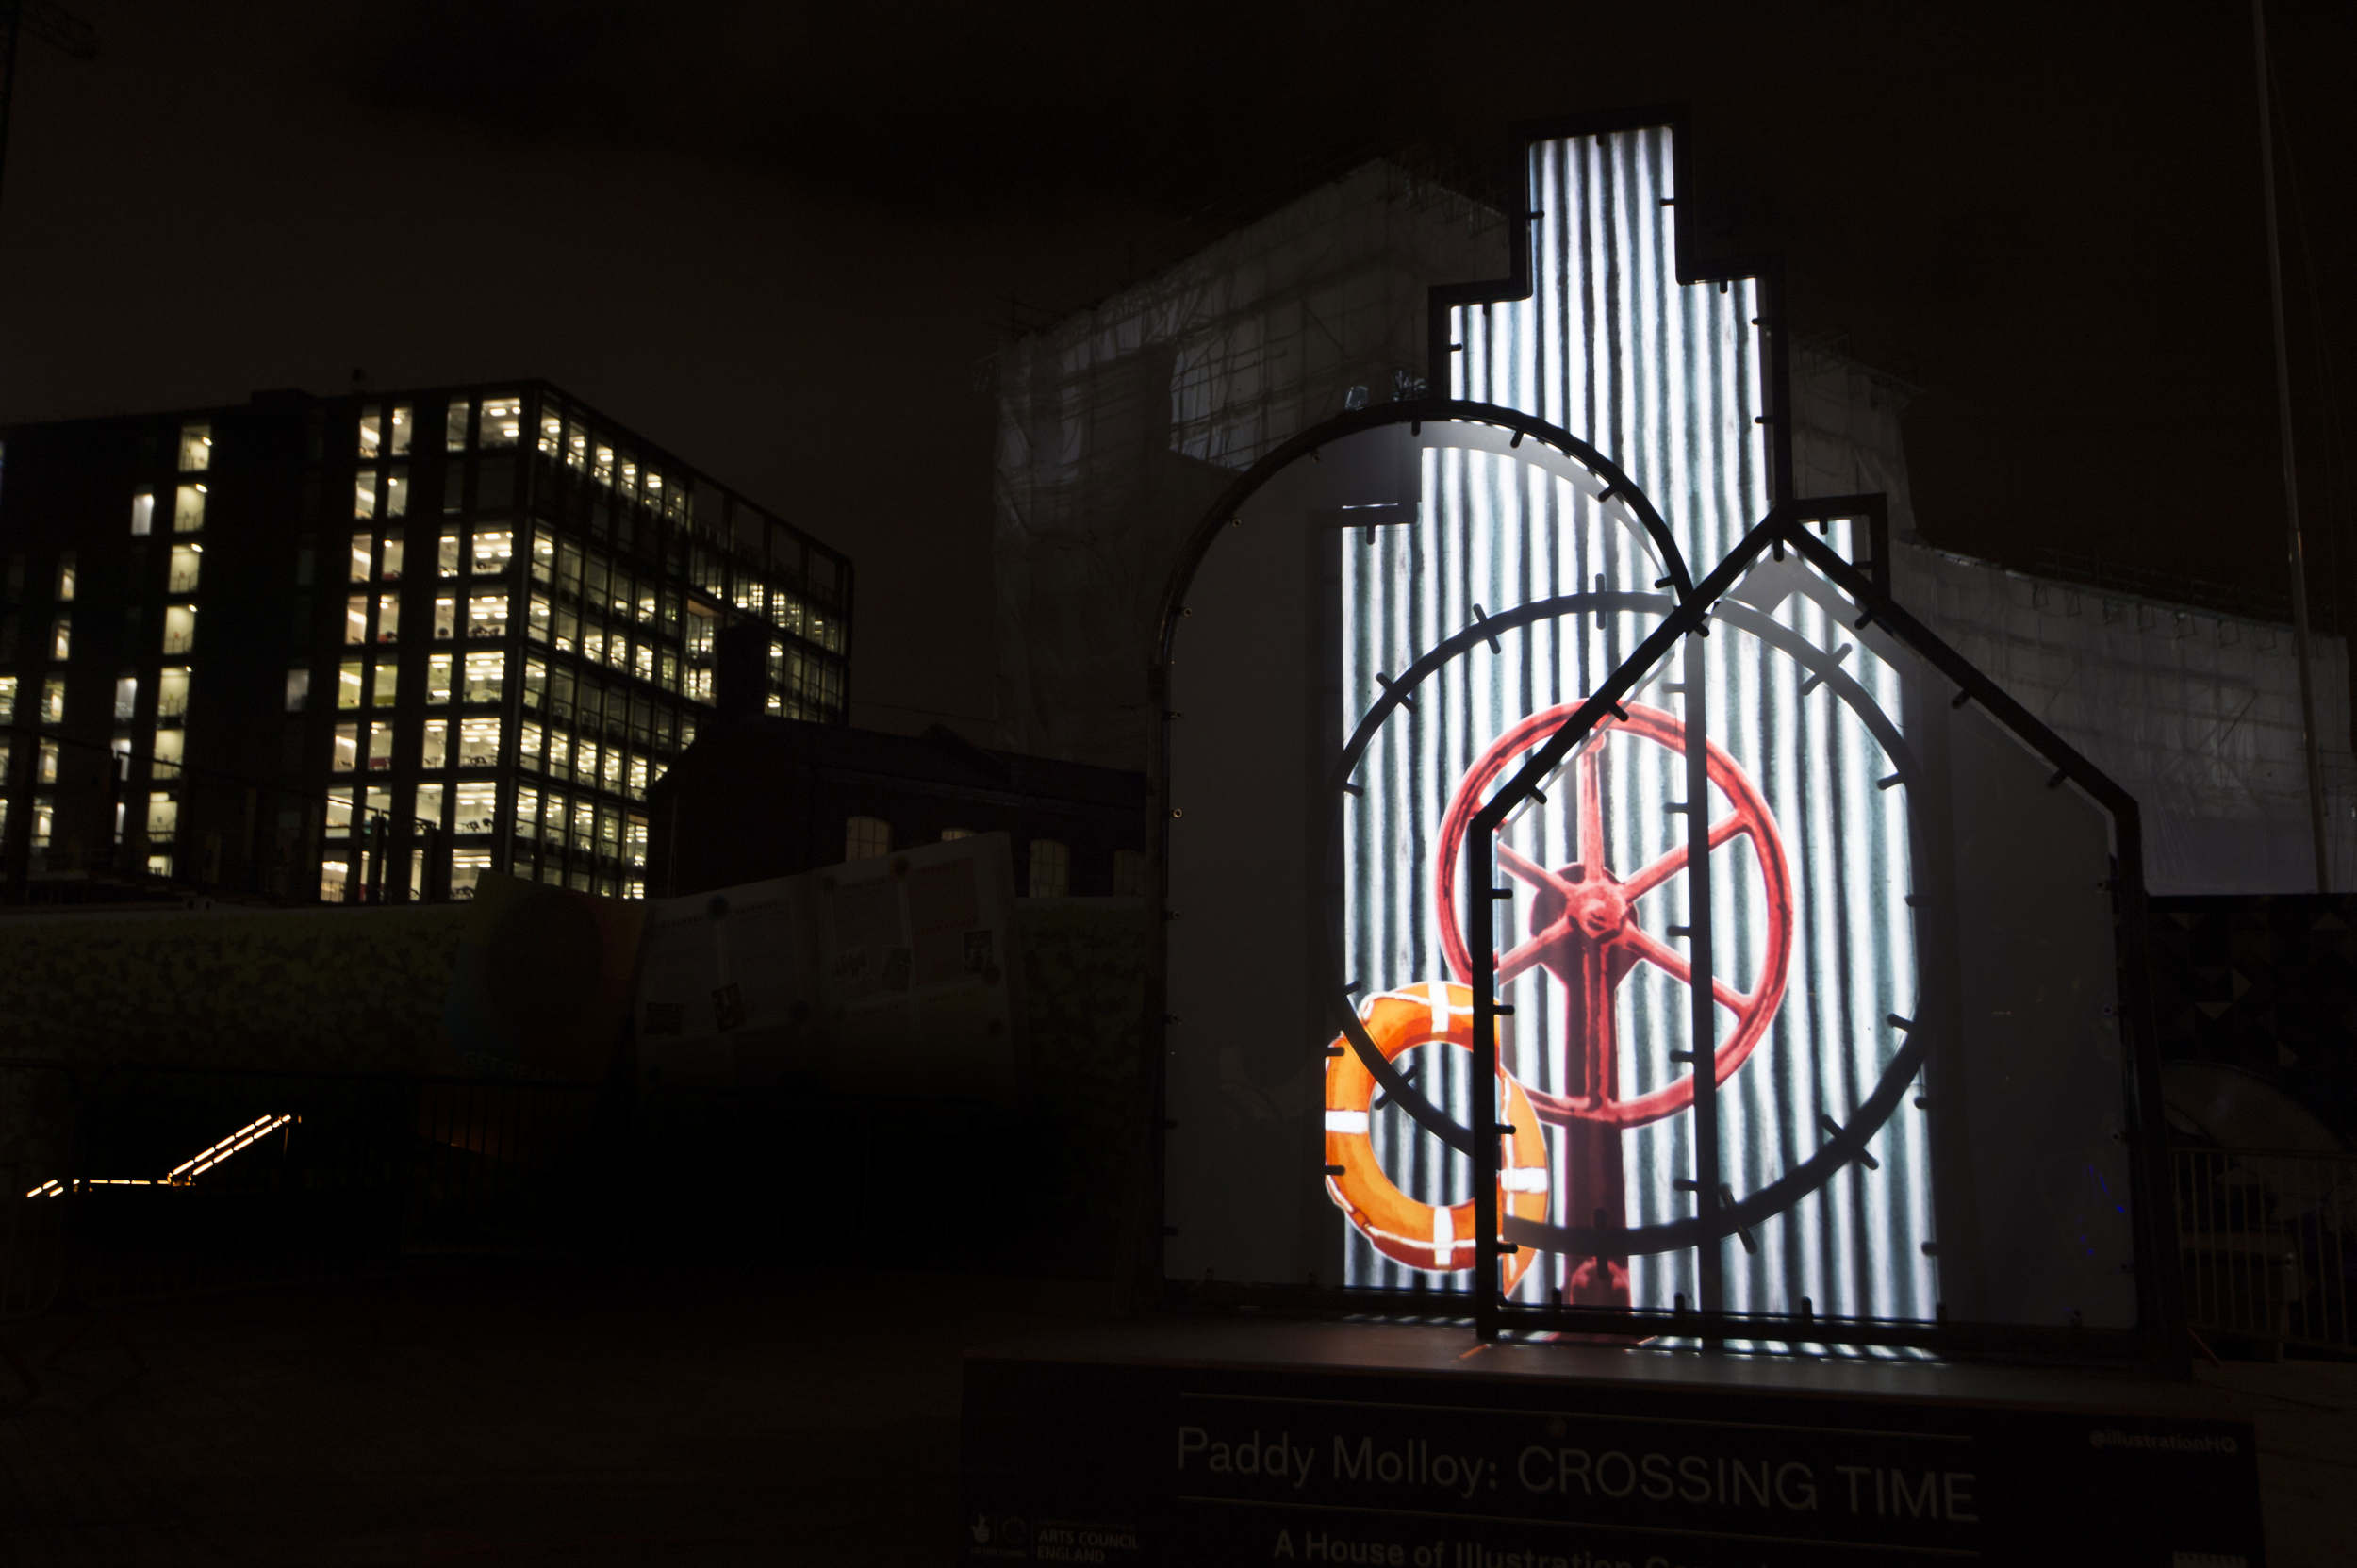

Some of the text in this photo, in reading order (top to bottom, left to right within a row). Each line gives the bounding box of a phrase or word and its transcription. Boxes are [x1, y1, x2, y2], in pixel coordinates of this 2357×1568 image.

[1178, 1426, 1980, 1523] Paddy Molloy: CROSSING TIME
[1036, 1544, 1107, 1564] ENGLAND
[1038, 1527, 1140, 1550] ARTS COUNCIL
[1273, 1528, 1296, 1560] A
[1305, 1531, 1405, 1567] House
[1413, 1539, 1446, 1568] of
